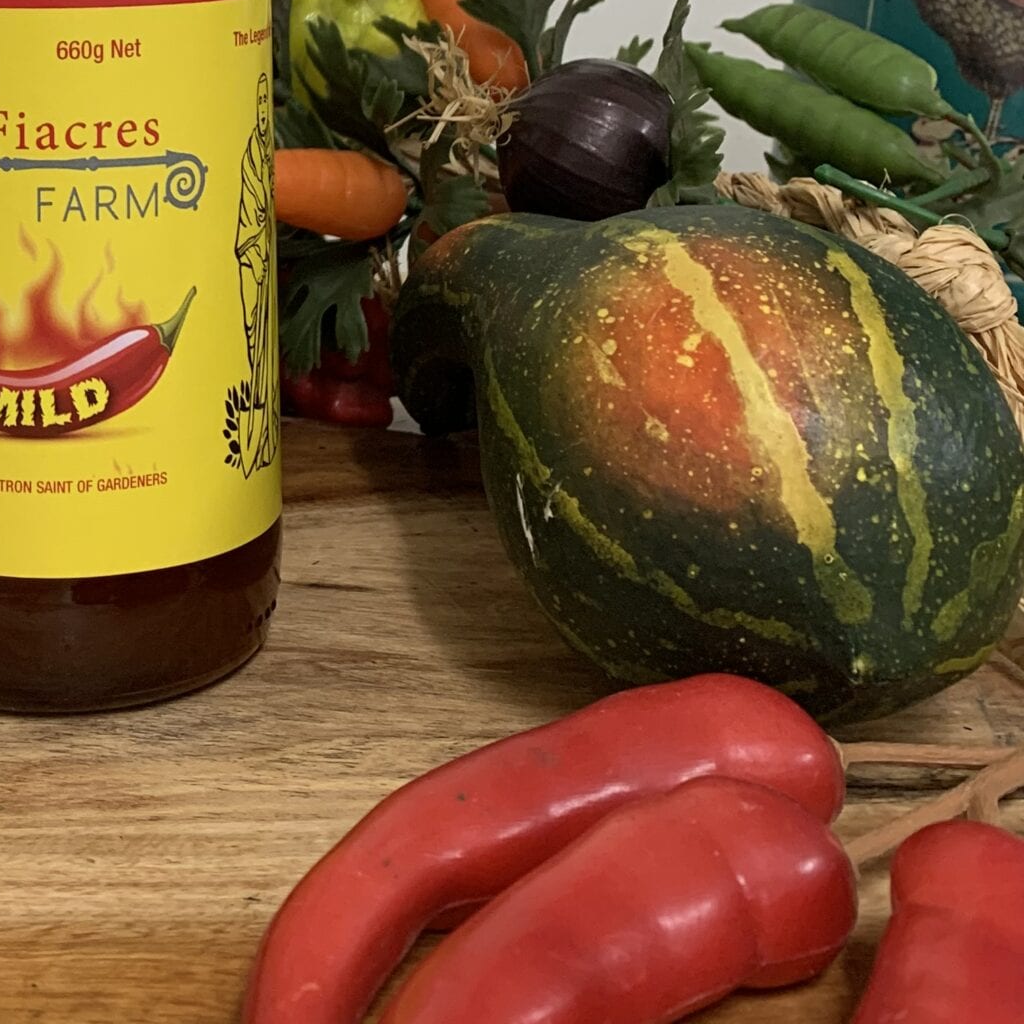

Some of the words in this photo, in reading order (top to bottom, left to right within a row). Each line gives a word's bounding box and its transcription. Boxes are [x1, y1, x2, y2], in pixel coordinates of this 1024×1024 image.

[56, 40, 104, 64] 660g
[111, 38, 141, 59] Net
[233, 31, 248, 47] The
[36, 184, 159, 222] FARM
[36, 480, 74, 494] SAINT
[77, 479, 93, 494] OF
[97, 472, 168, 492] GARDENERS
